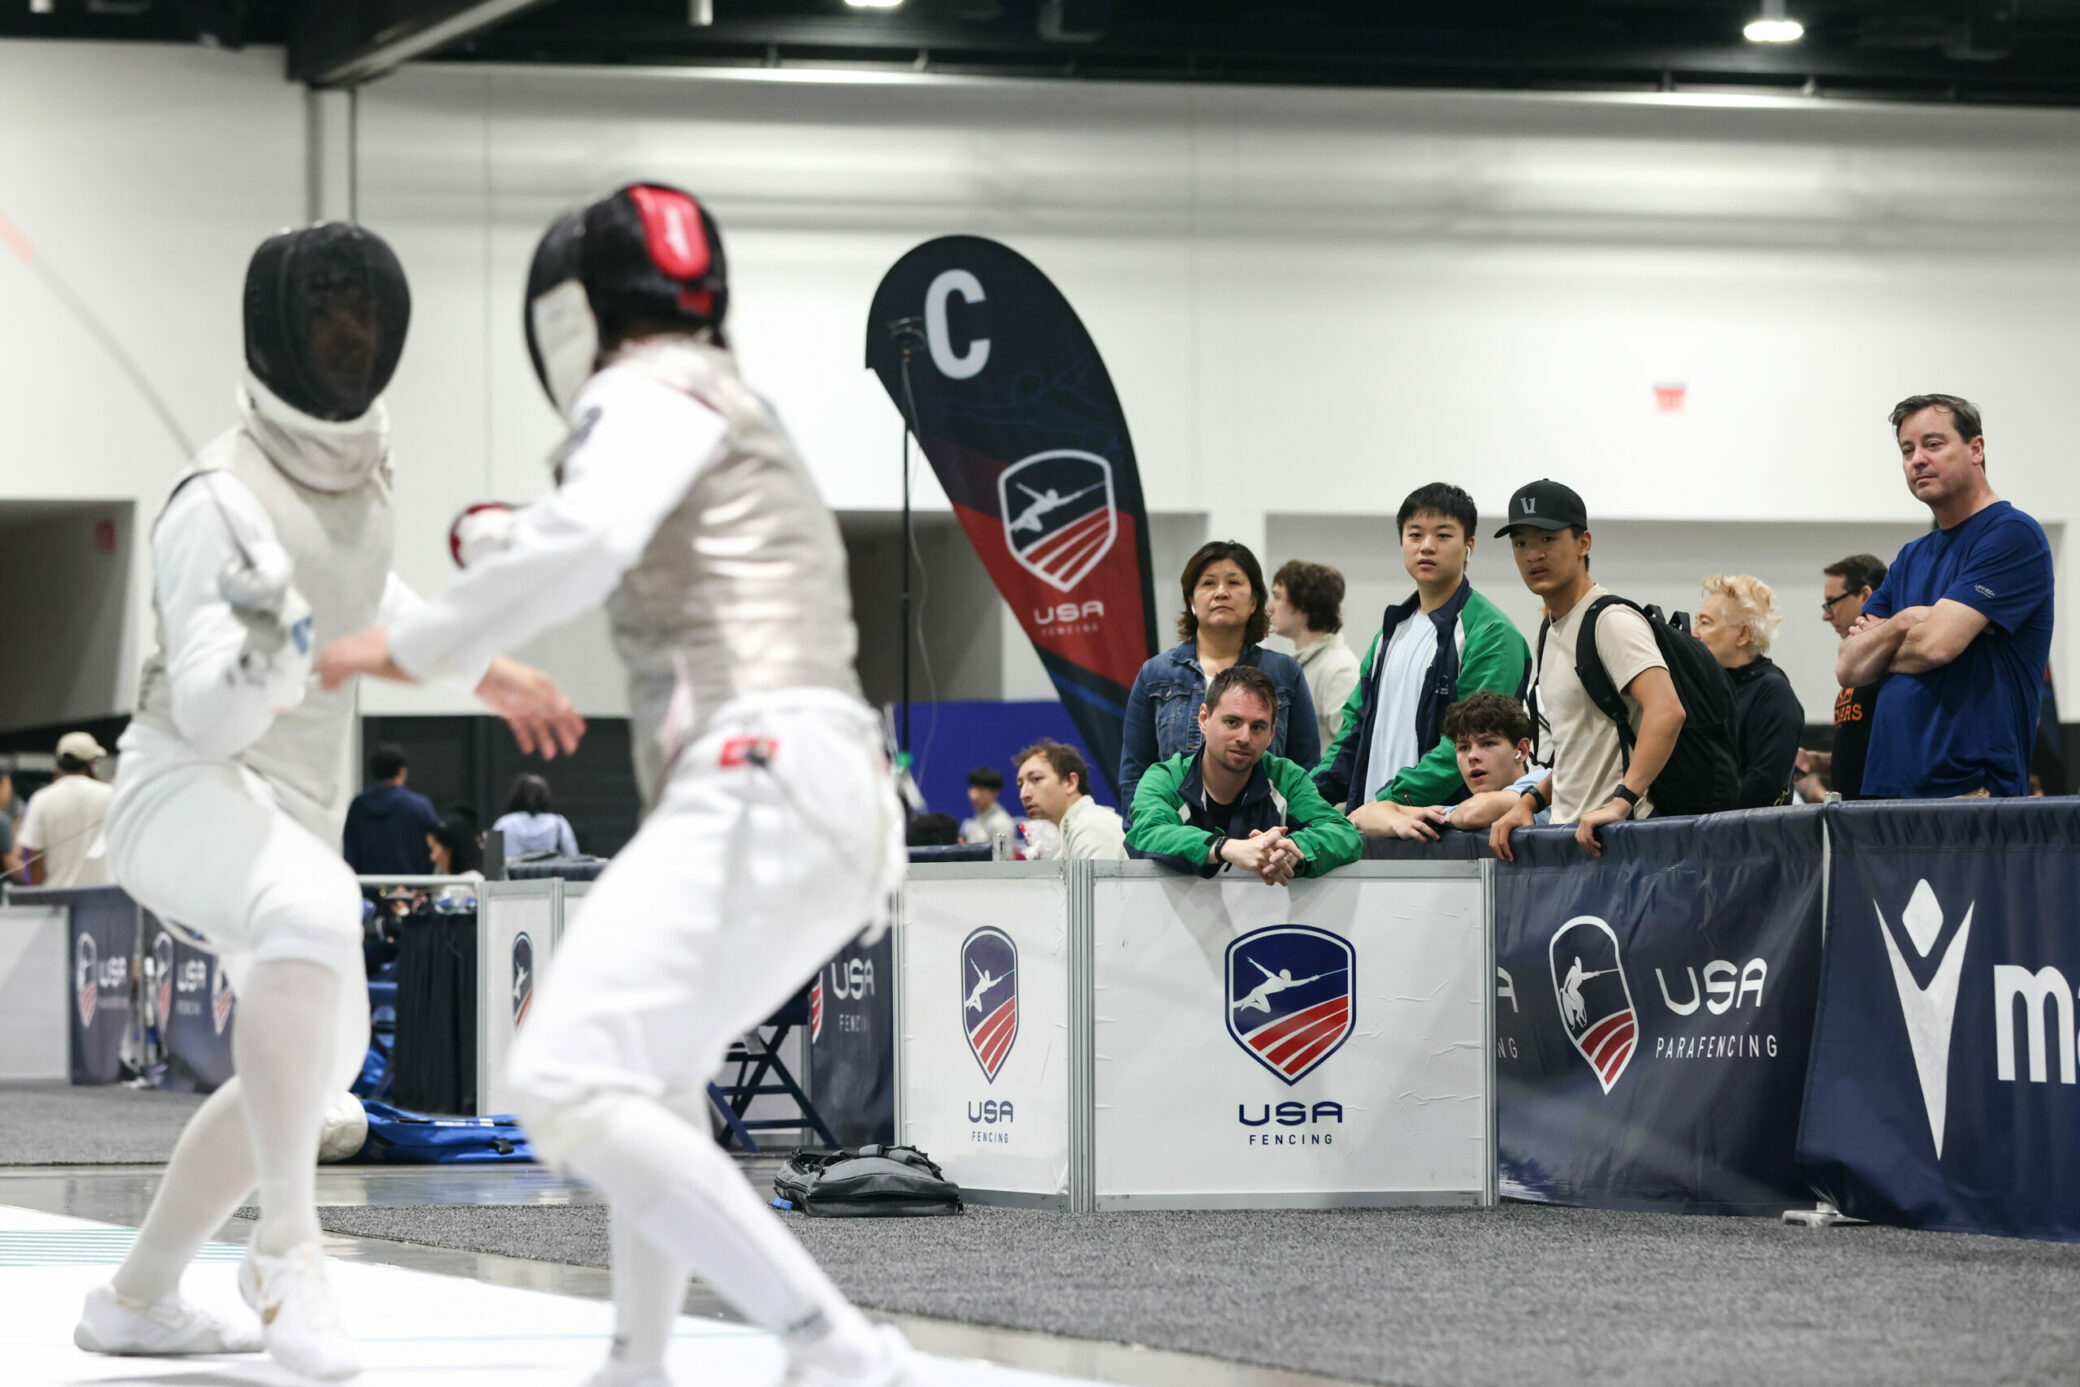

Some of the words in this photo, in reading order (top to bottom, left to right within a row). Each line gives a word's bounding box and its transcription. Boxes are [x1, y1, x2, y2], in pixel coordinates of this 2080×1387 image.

[925, 269, 991, 380] C
[1034, 600, 1104, 625] USA
[831, 958, 875, 1000] USA
[1655, 957, 1768, 1016] USA
[1655, 1034, 1778, 1059] PARAFENCING
[968, 1099, 1013, 1124] USA
[1239, 1101, 1343, 1126] USA
[971, 1130, 1009, 1144] FENCING
[1249, 1134, 1333, 1145] FENCING
